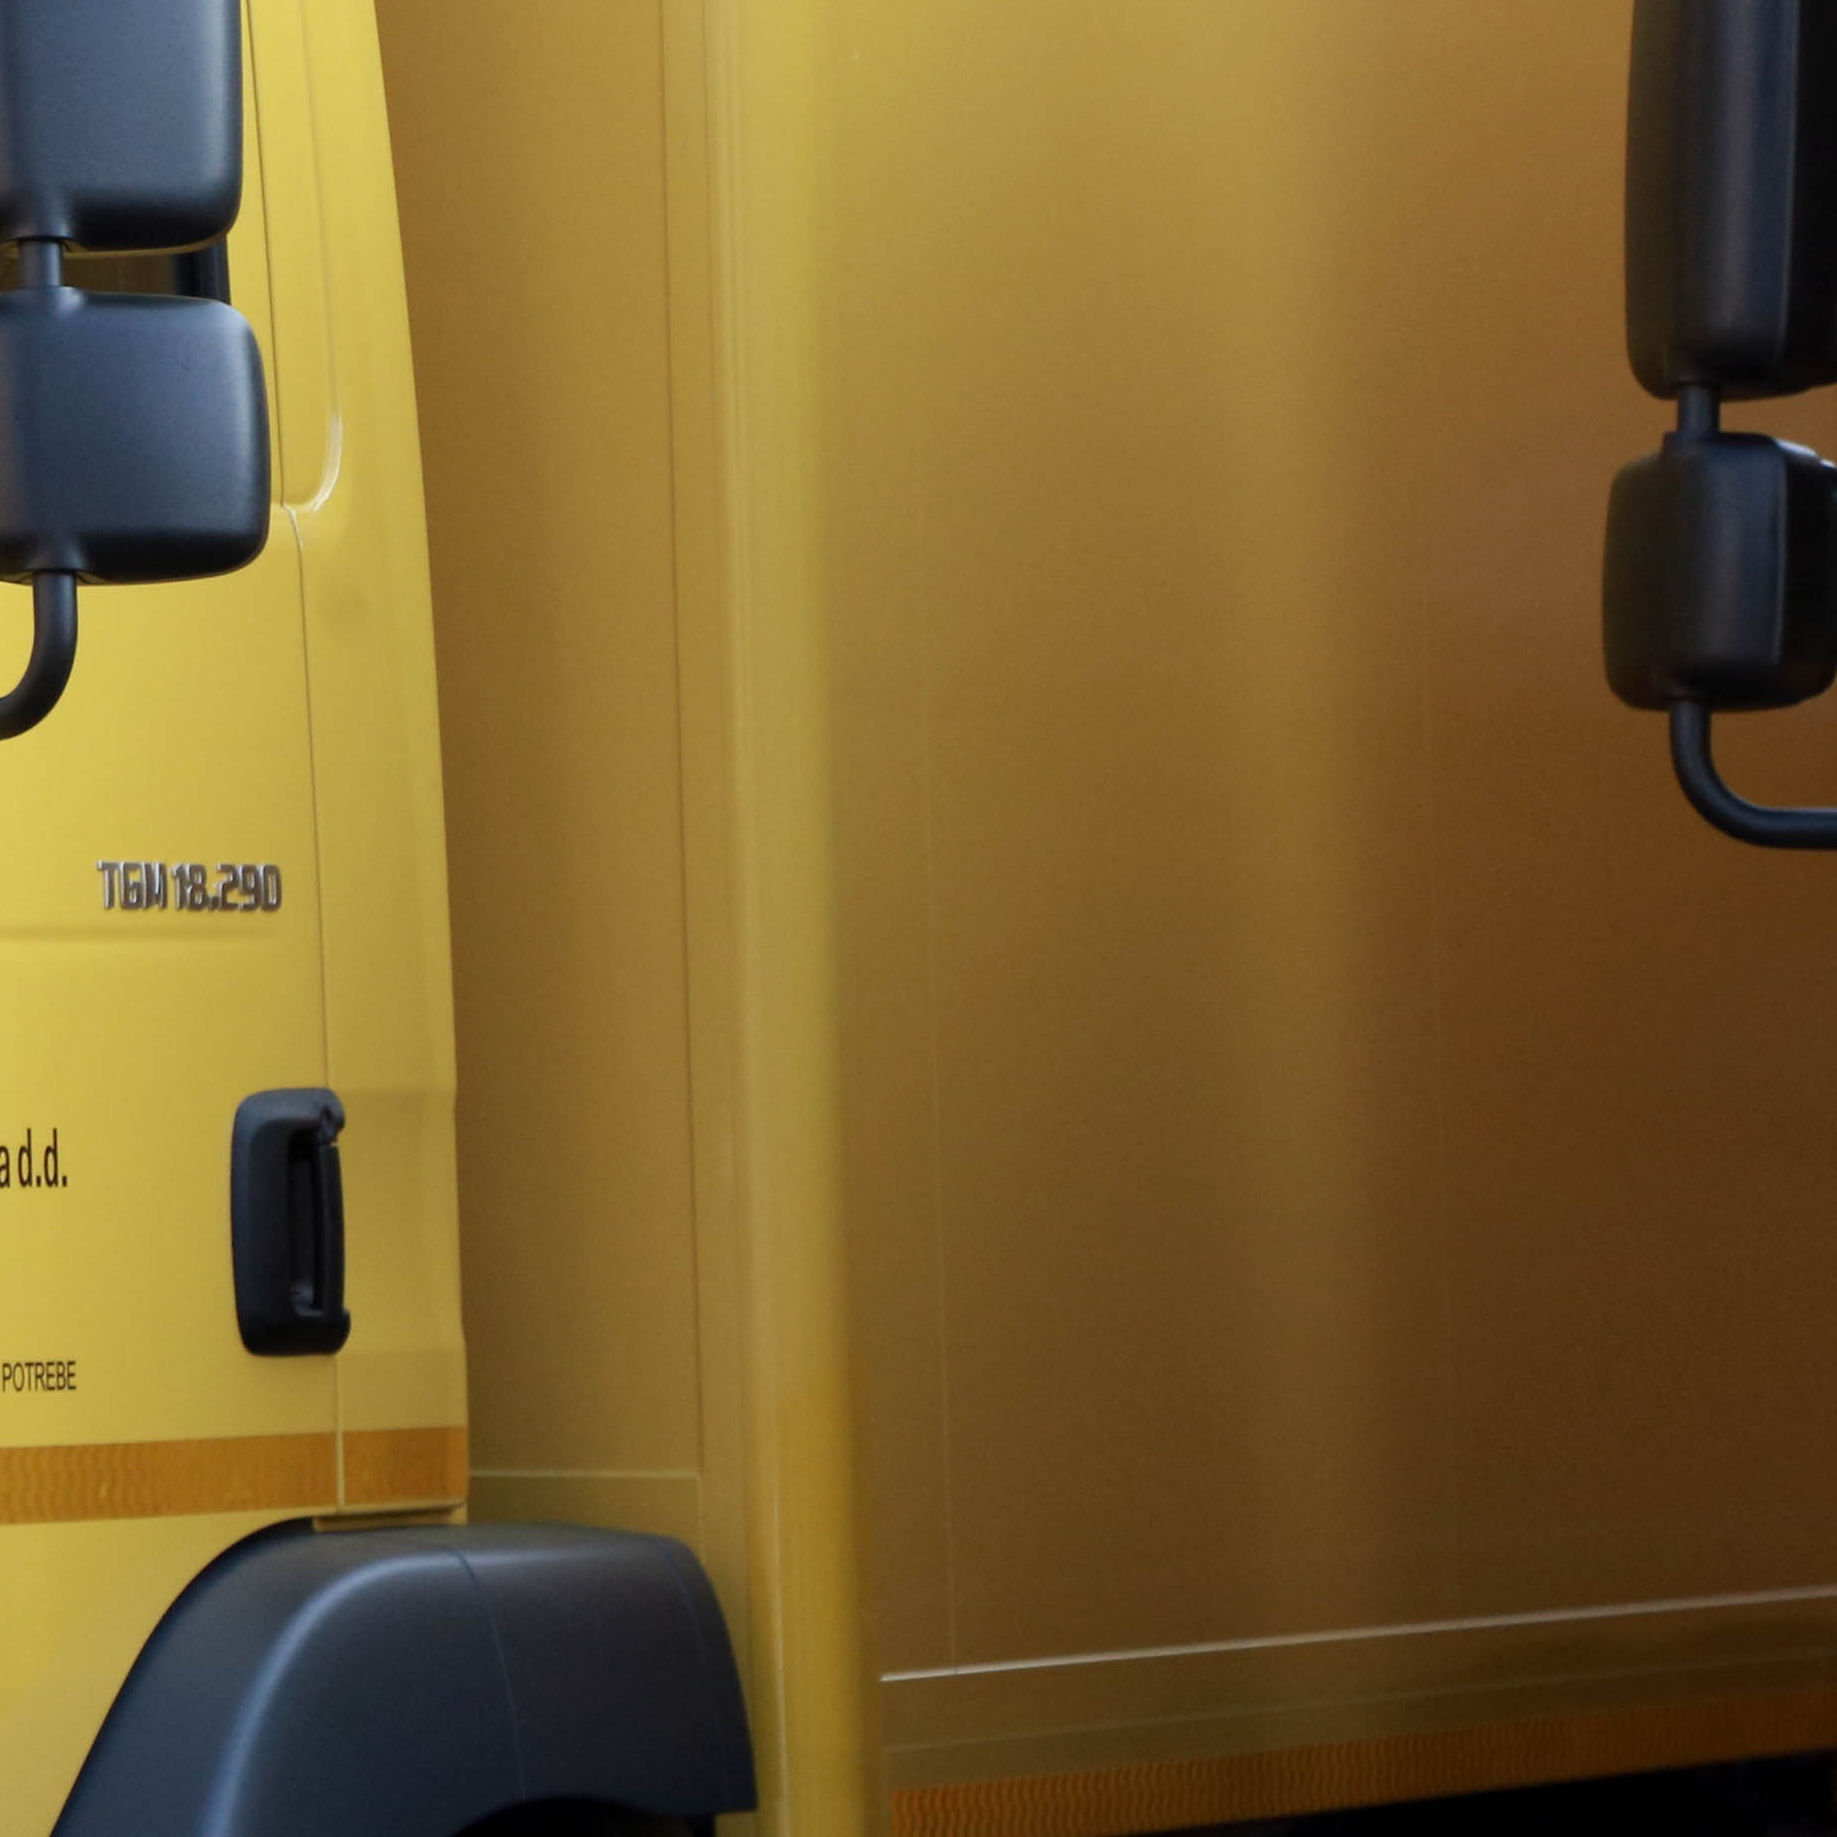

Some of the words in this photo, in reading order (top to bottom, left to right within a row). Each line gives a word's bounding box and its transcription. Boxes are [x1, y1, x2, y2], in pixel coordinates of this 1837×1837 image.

[97, 860, 168, 911] TGM
[171, 863, 283, 913] 18.290
[16, 1126, 69, 1188] d.d.
[1, 1360, 78, 1392] POTREBE
